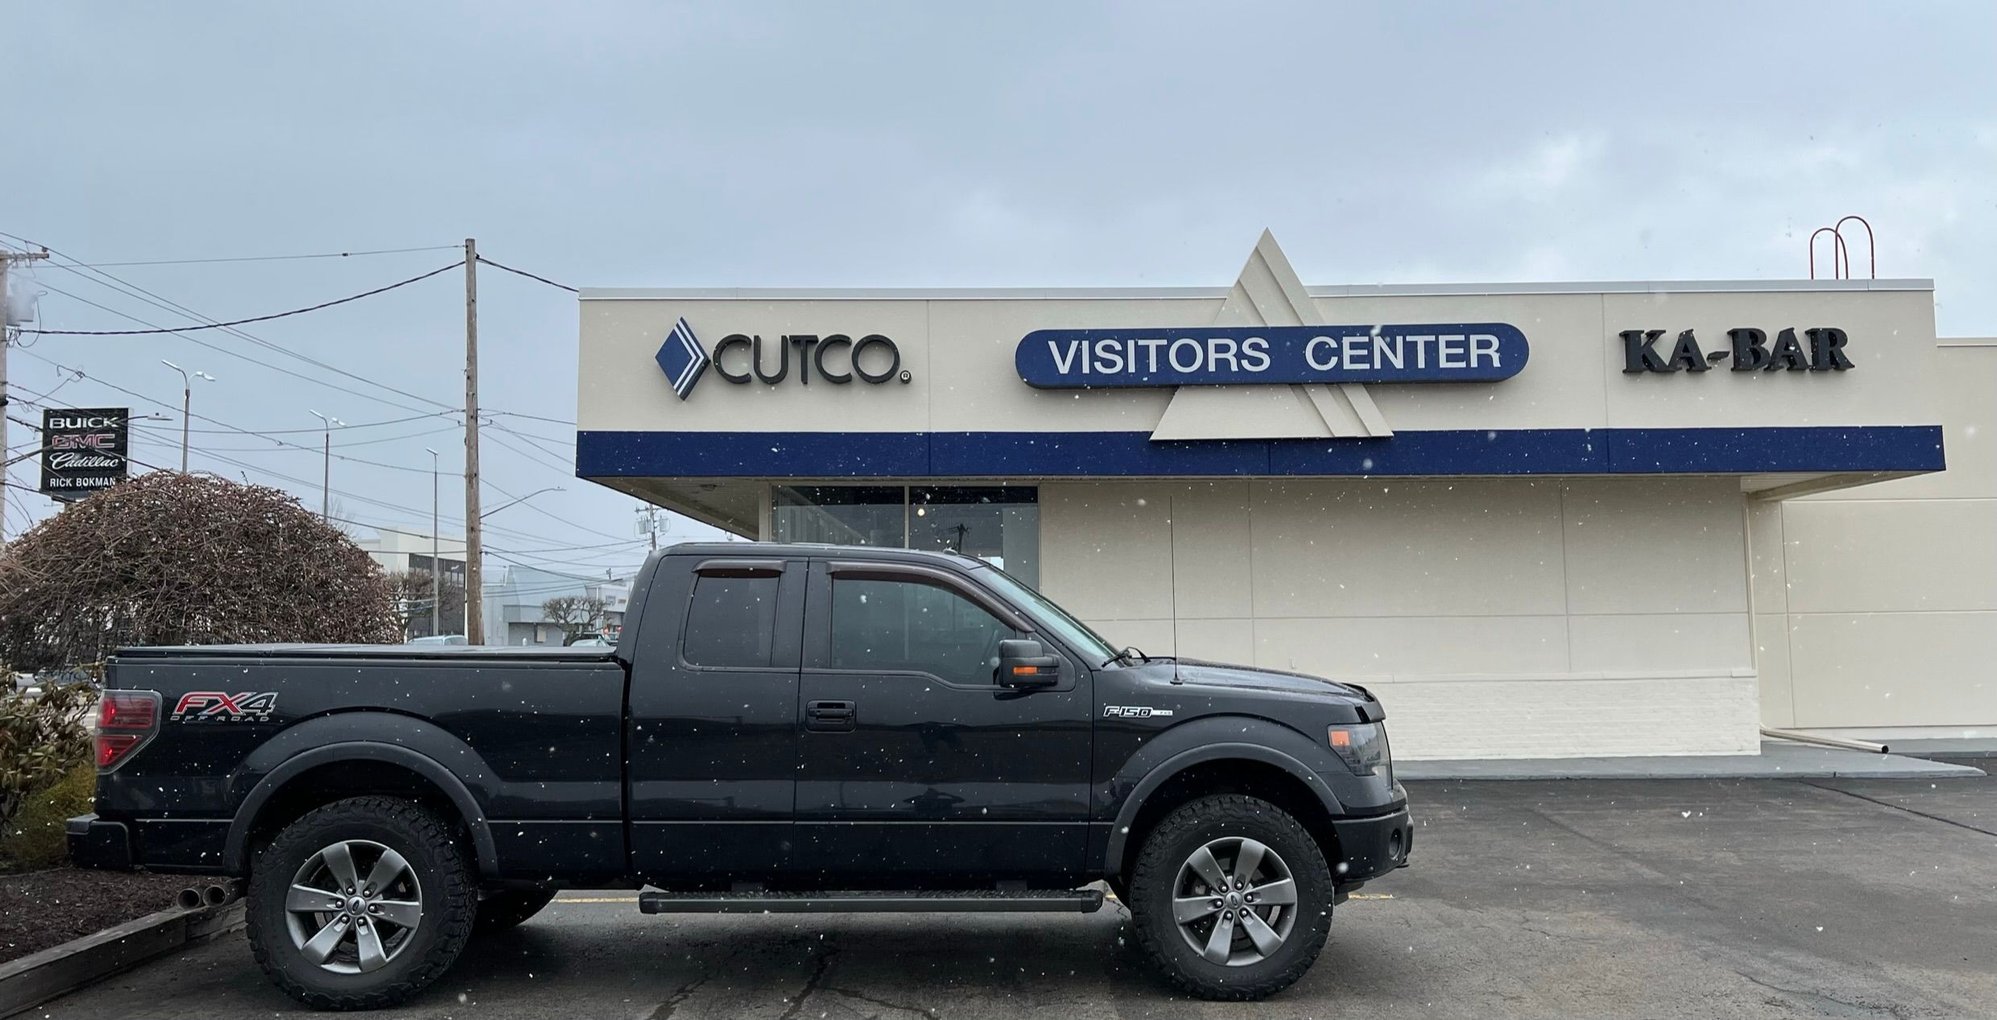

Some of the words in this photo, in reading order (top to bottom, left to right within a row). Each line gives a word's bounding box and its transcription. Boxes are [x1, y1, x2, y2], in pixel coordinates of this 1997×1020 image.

[712, 333, 901, 385] CUTCO
[1047, 336, 1271, 375] VISITORS
[1304, 333, 1502, 371] CENTER
[1618, 327, 1856, 374] KA-BAR
[49, 416, 119, 429] BUICK
[51, 433, 116, 450] GMC
[49, 452, 119, 470] Cadillac
[50, 477, 73, 488] RICK
[75, 476, 116, 488] BOKMAN
[172, 691, 279, 716] FX4
[1103, 705, 1154, 718] F-150
